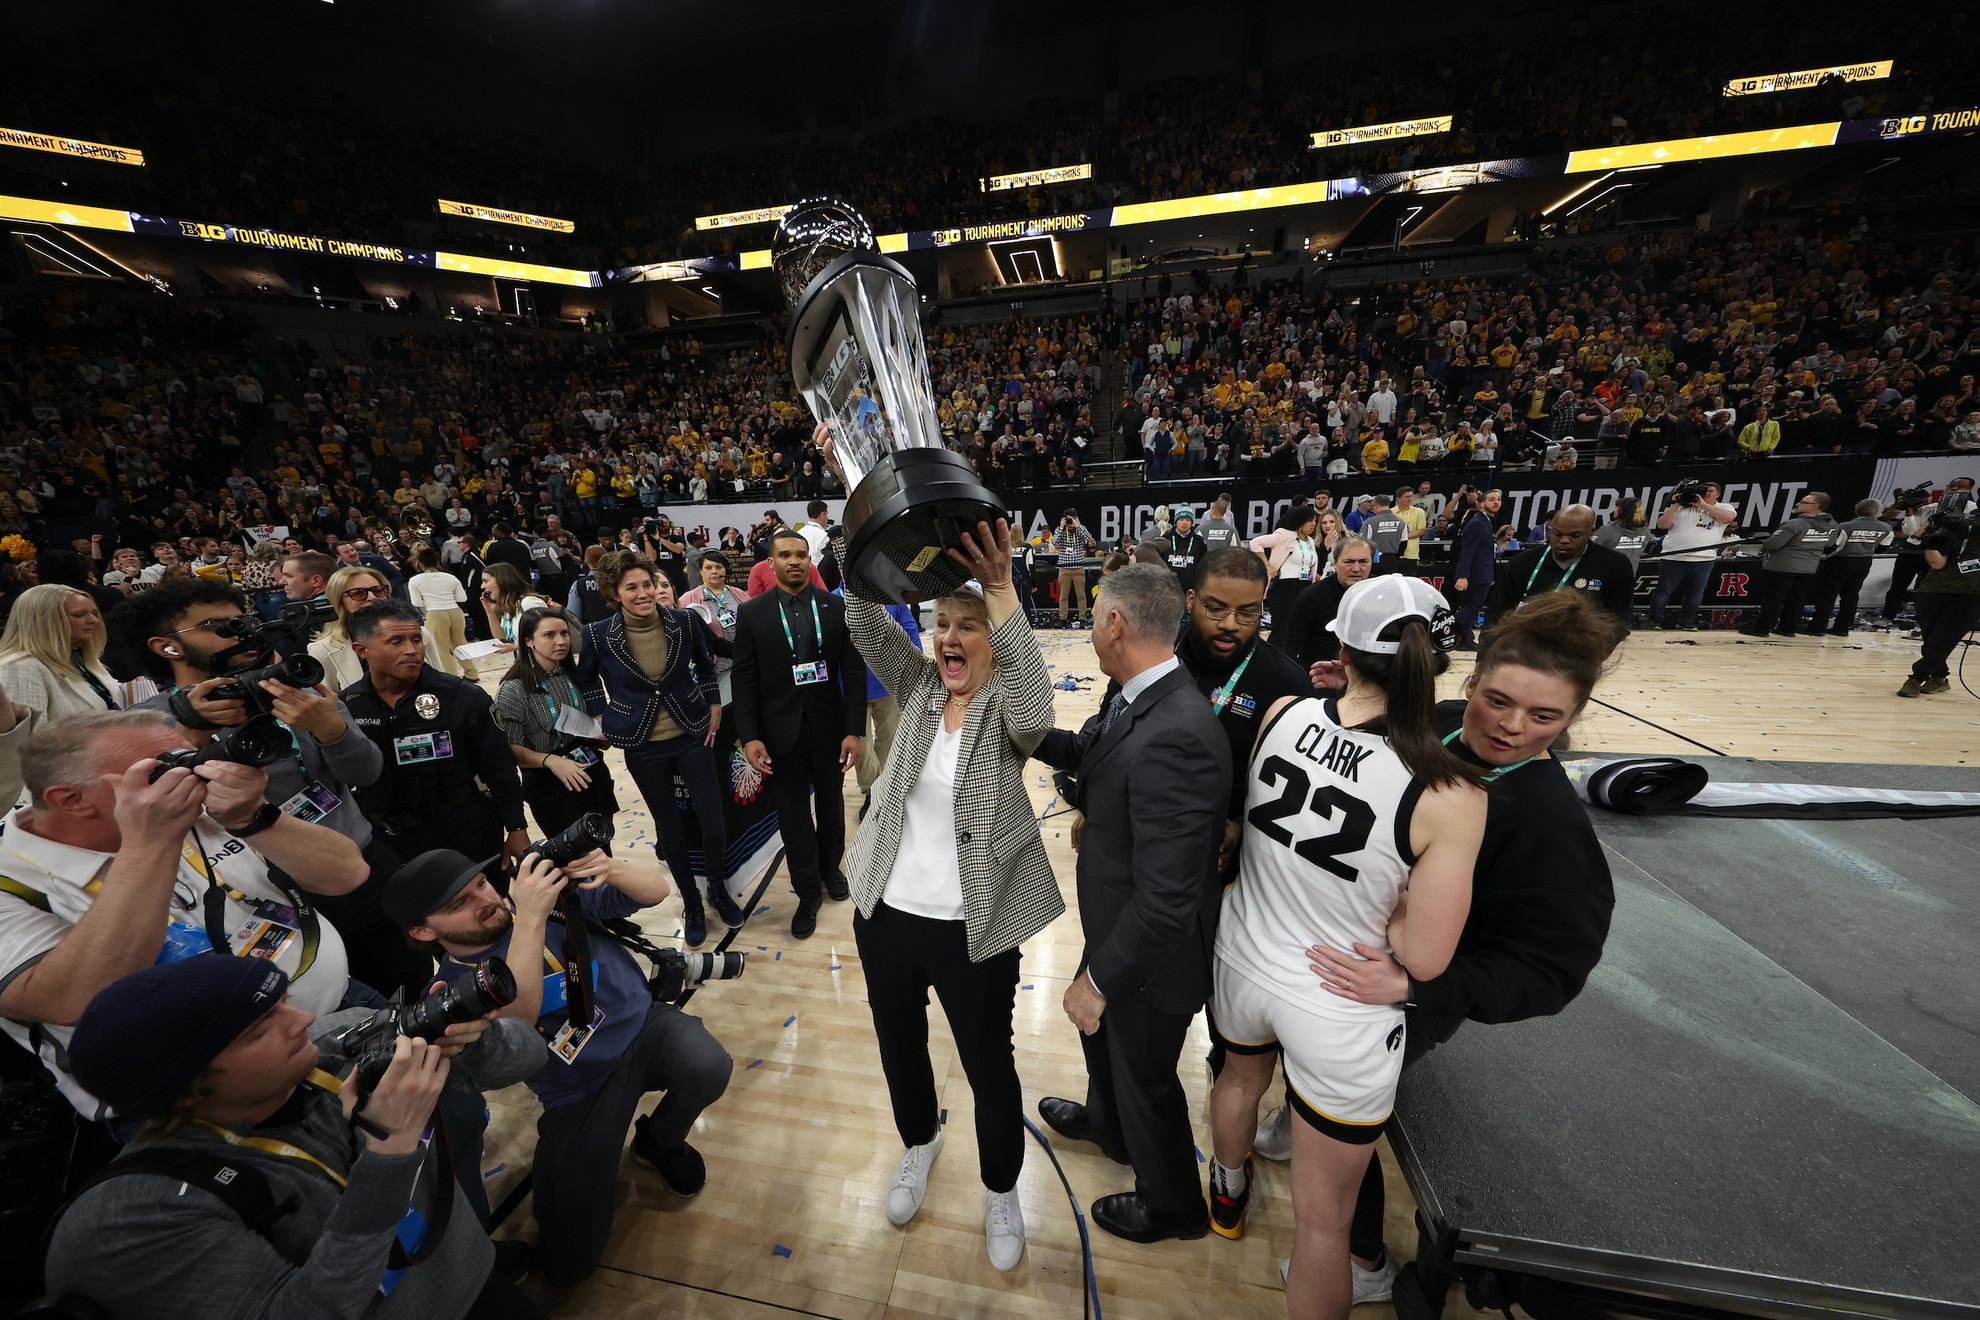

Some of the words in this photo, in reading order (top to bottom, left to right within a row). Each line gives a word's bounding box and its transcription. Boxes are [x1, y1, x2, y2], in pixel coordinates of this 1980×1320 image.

[1345, 126, 1393, 141] TOURNAMENT
[1395, 120, 1440, 135] CHAMPIONS
[59, 140, 127, 160] CHAMPIONS
[963, 221, 1026, 241] TOURNAMENT
[1028, 214, 1085, 234] CHAMPIONS
[229, 227, 324, 252] TOURNAMENT
[327, 240, 404, 262] CHAMPIONS
[1419, 260, 1435, 270] 112
[1010, 302, 1024, 310] 110
[1295, 723, 1375, 783] CLARK
[1248, 753, 1377, 883] 22
[288, 888, 305, 908] Nikon
[568, 960, 579, 983] EOS
